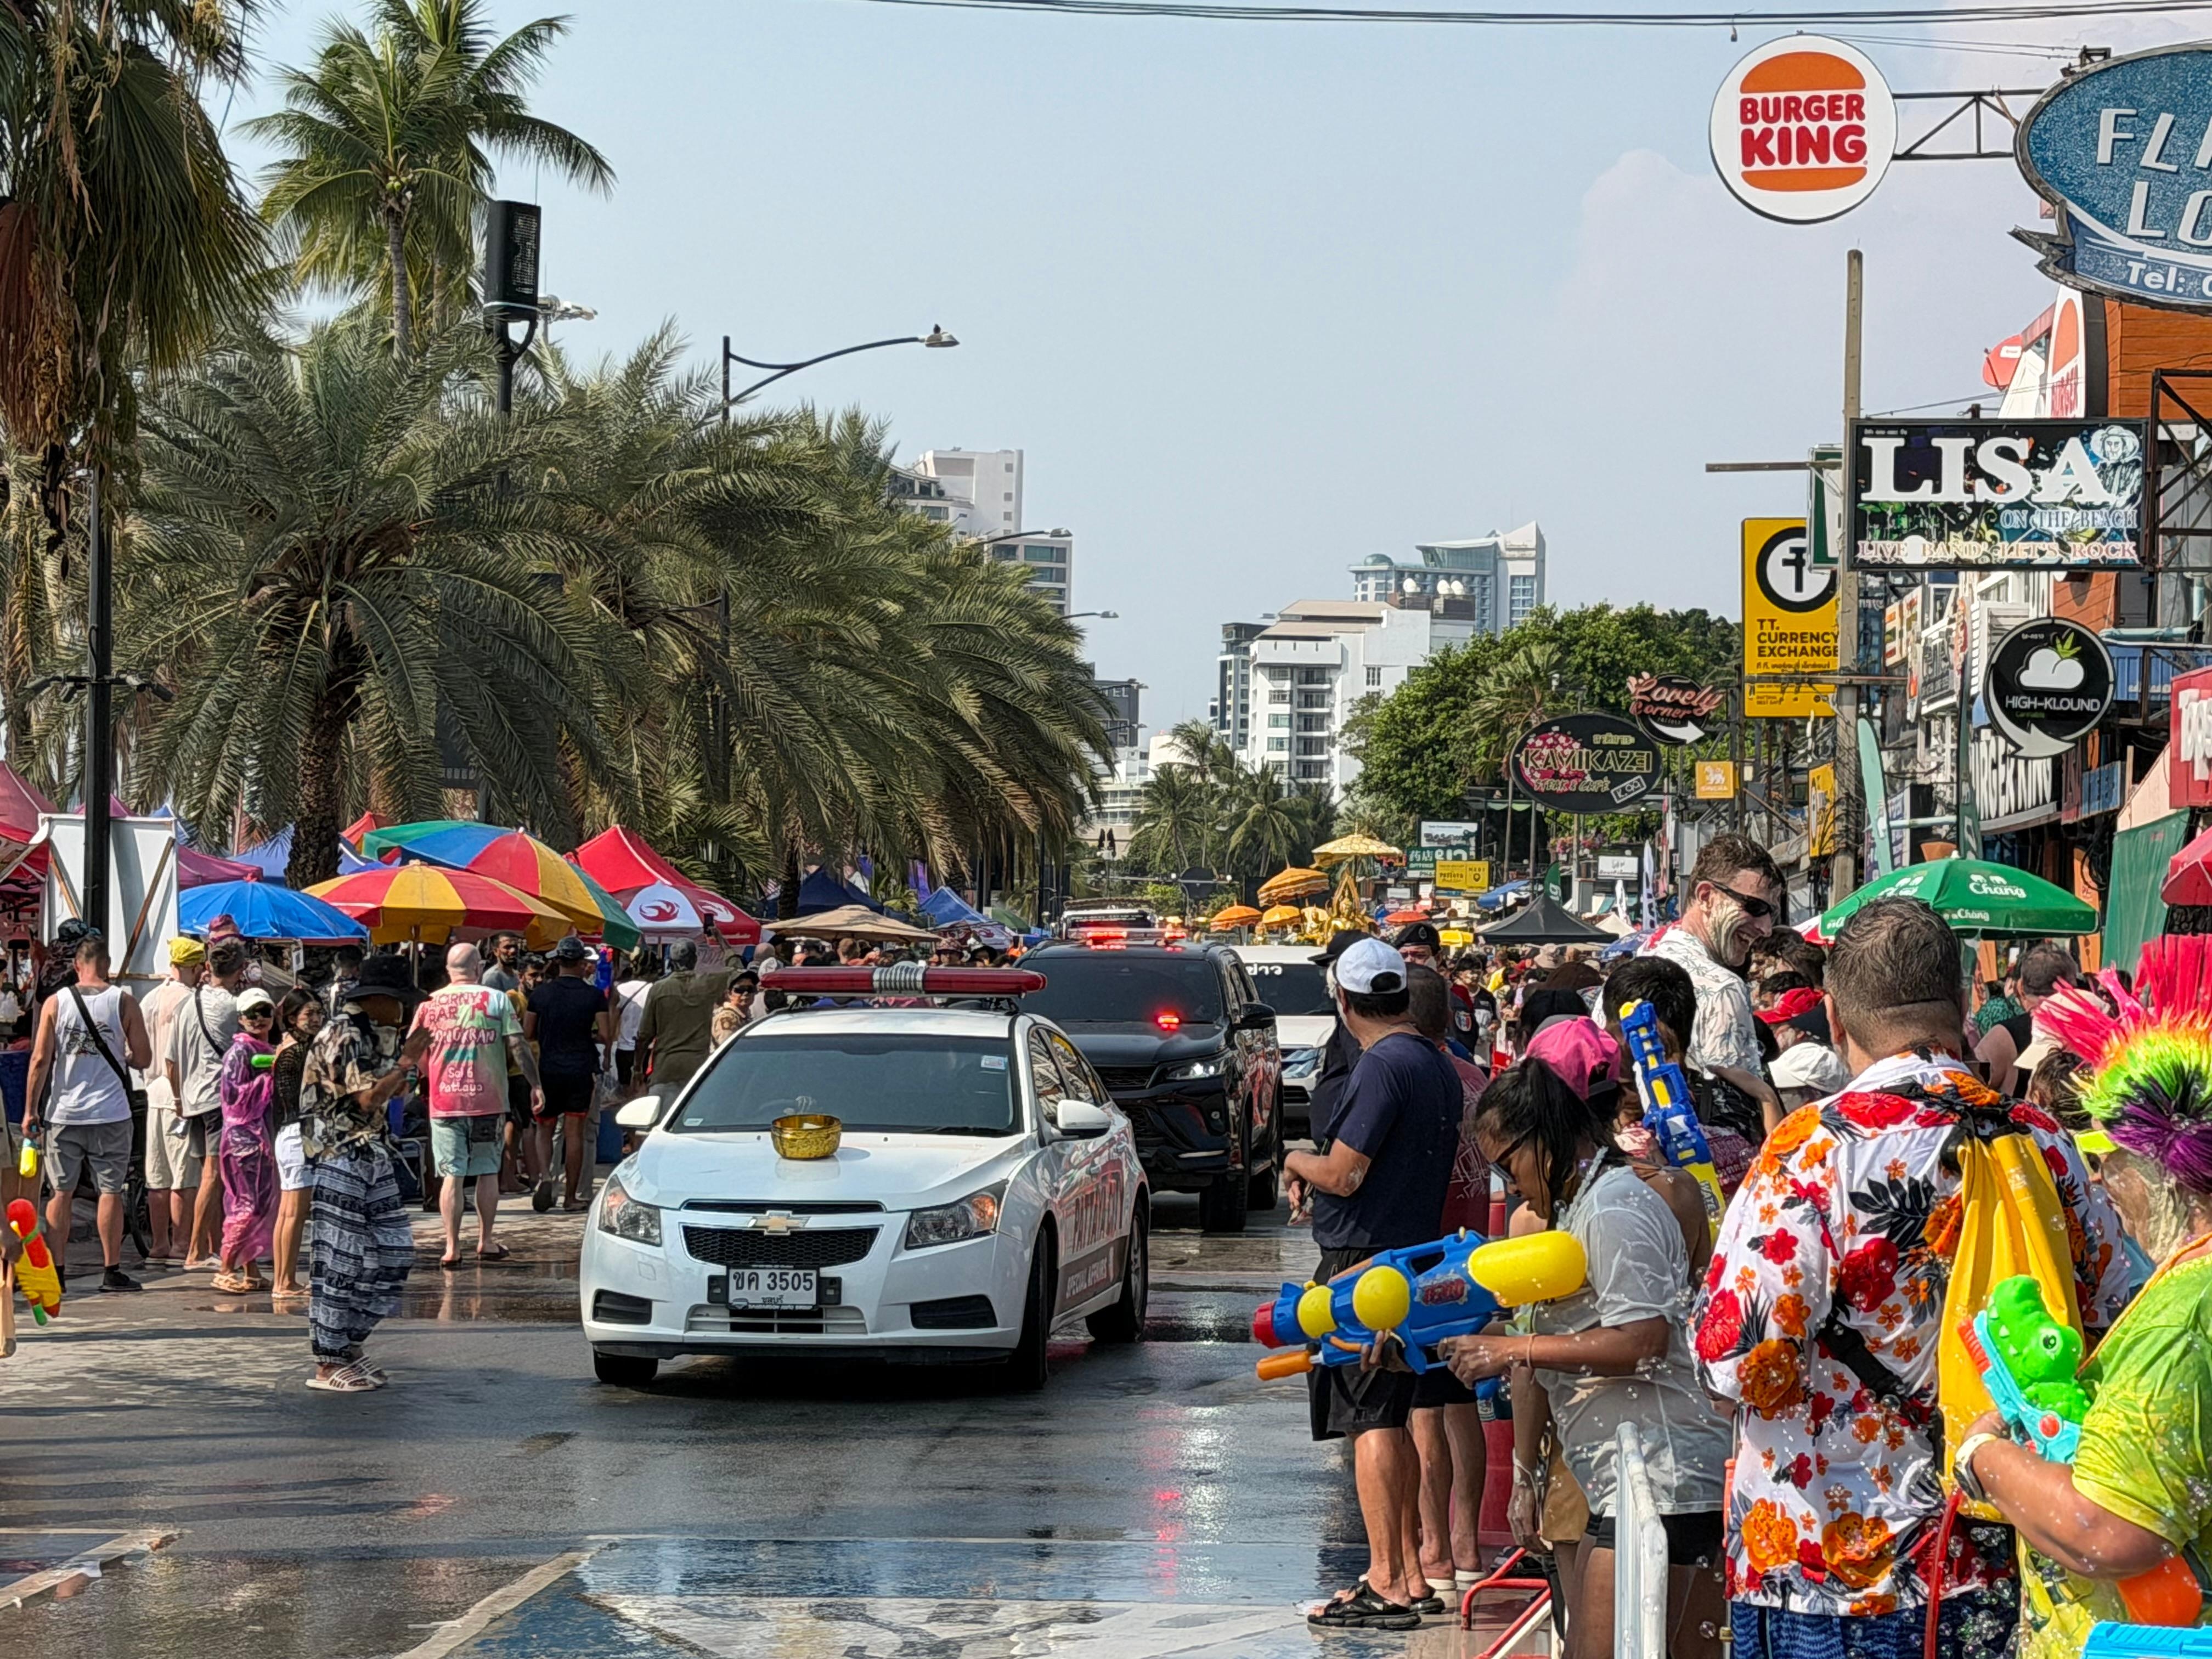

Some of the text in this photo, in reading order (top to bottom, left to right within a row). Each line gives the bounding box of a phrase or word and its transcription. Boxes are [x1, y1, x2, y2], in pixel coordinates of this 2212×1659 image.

[1740, 93, 1865, 125] BURGER
[1741, 124, 1866, 167] KING
[2126, 261, 2186, 293] Tel:
[1860, 437, 2118, 503] LISA
[2000, 509, 2138, 528] ON THE BEACH
[1857, 540, 1908, 559] LIVE
[2070, 540, 2136, 558] ROCK
[1757, 619, 1780, 630] TT.
[1757, 631, 1839, 644] CURRENCY
[1757, 646, 1839, 657] EXCHANGE
[1633, 678, 1725, 716] Lovely
[2005, 695, 2101, 712] HIGH-KLOUND
[1629, 701, 1692, 718] Corner
[1968, 732, 2015, 821] URGER
[1969, 883, 2027, 898] Chang
[1957, 909, 1990, 921] Chang
[467, 1066, 473, 1078] 6
[439, 1081, 483, 1096] Pattaya
[767, 1272, 813, 1291] 3505
